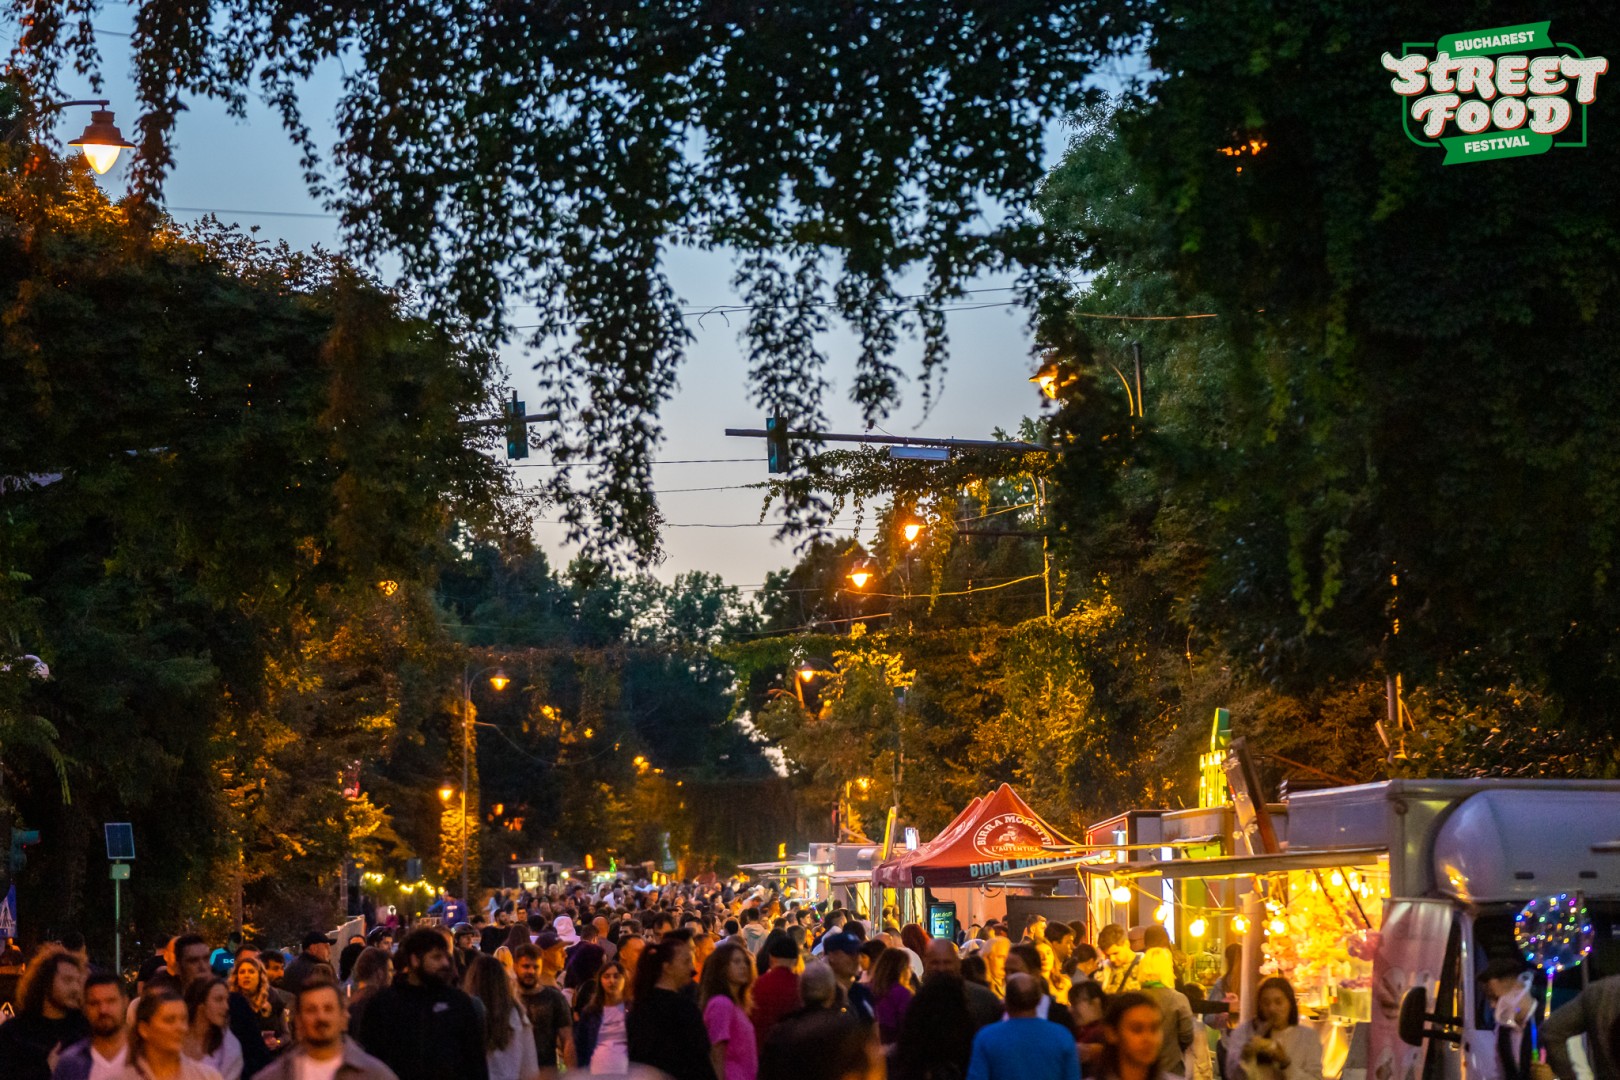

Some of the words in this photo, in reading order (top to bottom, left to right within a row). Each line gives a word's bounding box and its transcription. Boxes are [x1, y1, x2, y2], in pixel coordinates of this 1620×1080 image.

[977, 819, 1004, 845] BIRRA
[1004, 815, 1052, 845] MORETTI
[970, 859, 1011, 877] BIRRA
